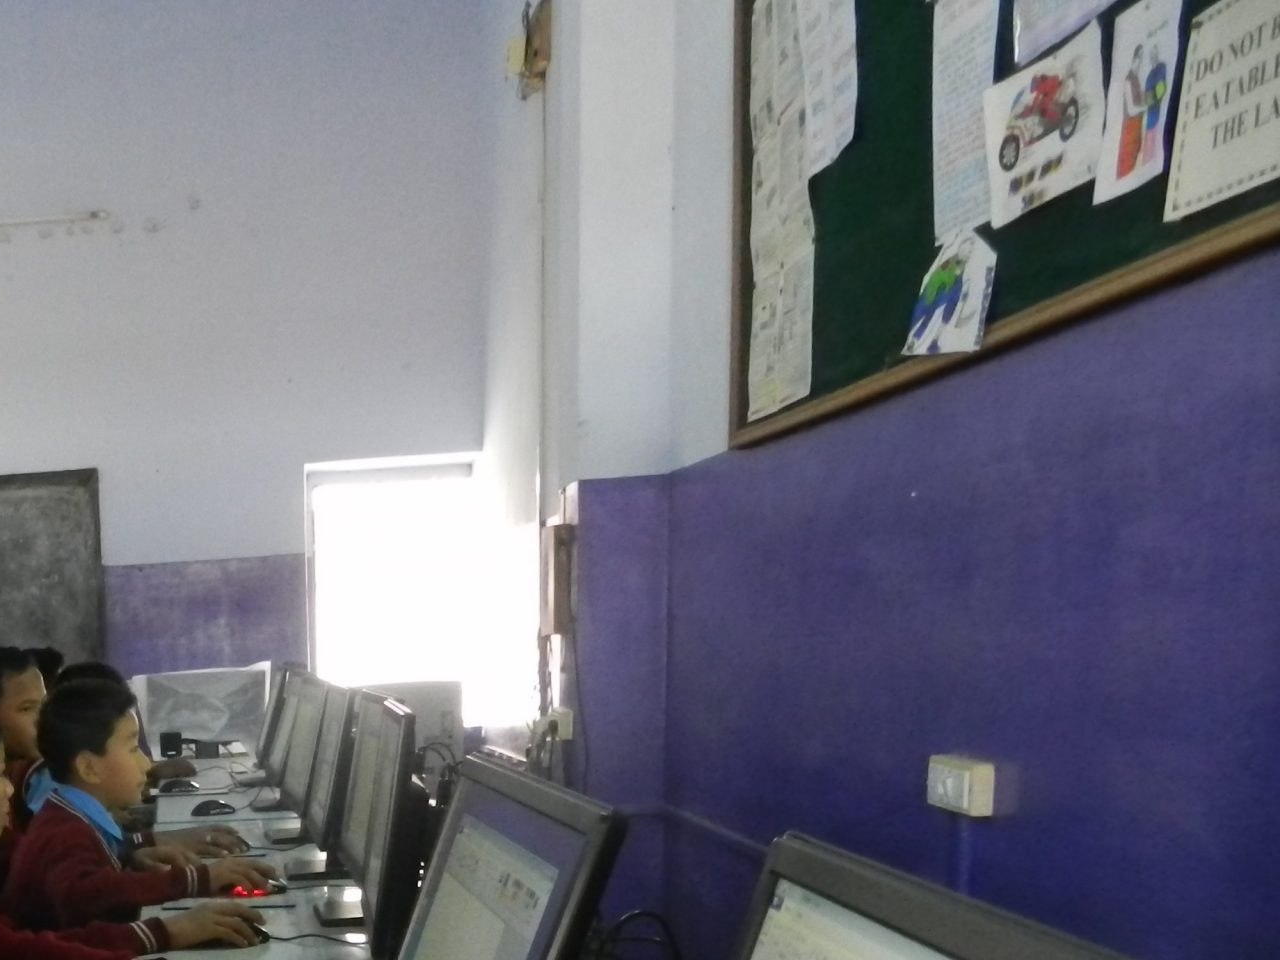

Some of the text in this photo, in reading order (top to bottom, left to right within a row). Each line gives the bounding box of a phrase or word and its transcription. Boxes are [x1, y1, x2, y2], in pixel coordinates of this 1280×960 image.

[1195, 50, 1224, 82] DO
[1226, 21, 1268, 66] NOT
[1211, 109, 1249, 149] THE
